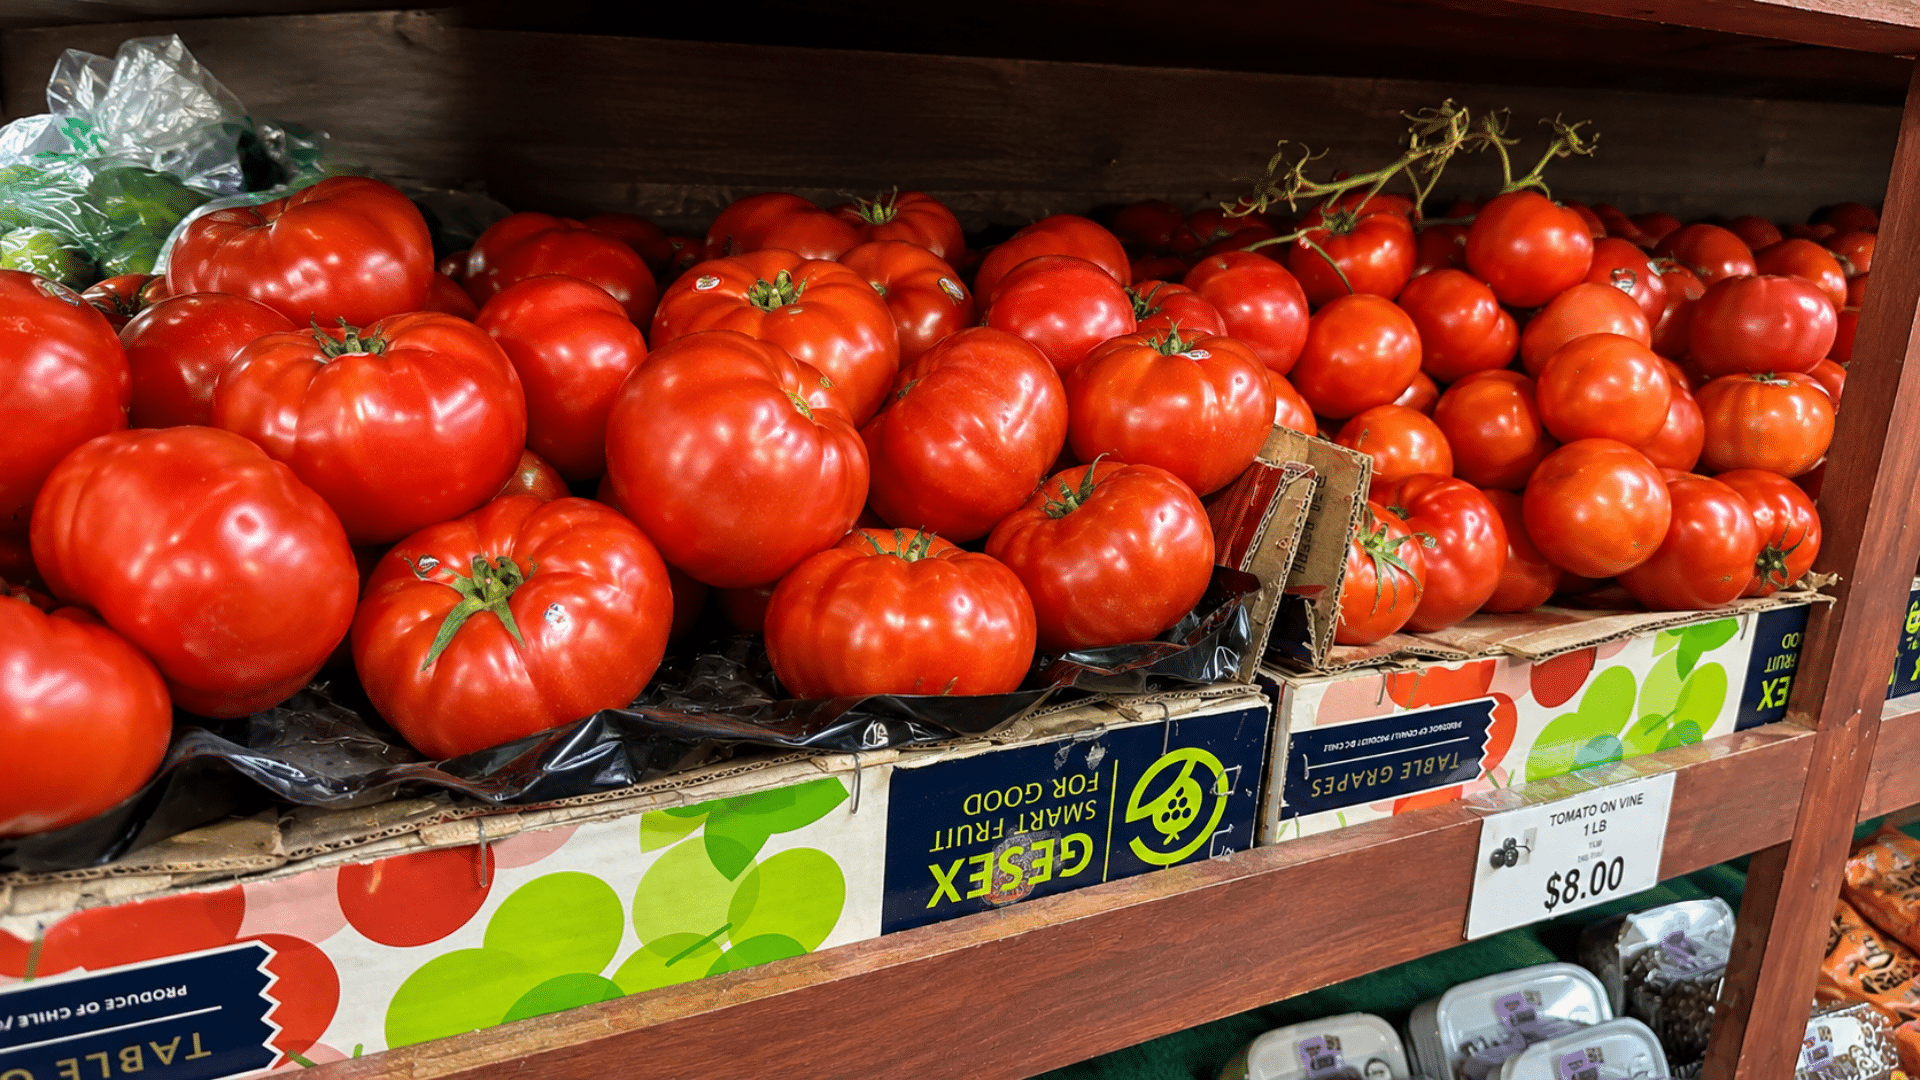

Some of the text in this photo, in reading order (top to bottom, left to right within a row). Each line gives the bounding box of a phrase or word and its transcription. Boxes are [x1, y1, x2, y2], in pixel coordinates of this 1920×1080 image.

[963, 771, 1099, 816] FOR GOOD
[1311, 752, 1459, 798] TABLE GRAPES
[929, 799, 1097, 853] SMART FRUIT
[1549, 793, 1644, 827] TOMATO ON VINE
[1584, 820, 1607, 836] 1 LB
[926, 832, 1094, 909] GESEX
[1543, 855, 1624, 913] $8.00
[18, 1006, 71, 1028] CHILE
[75, 1001, 100, 1016] OF
[105, 984, 188, 1011] PRODUCE
[56, 1031, 212, 1080] TABLE
